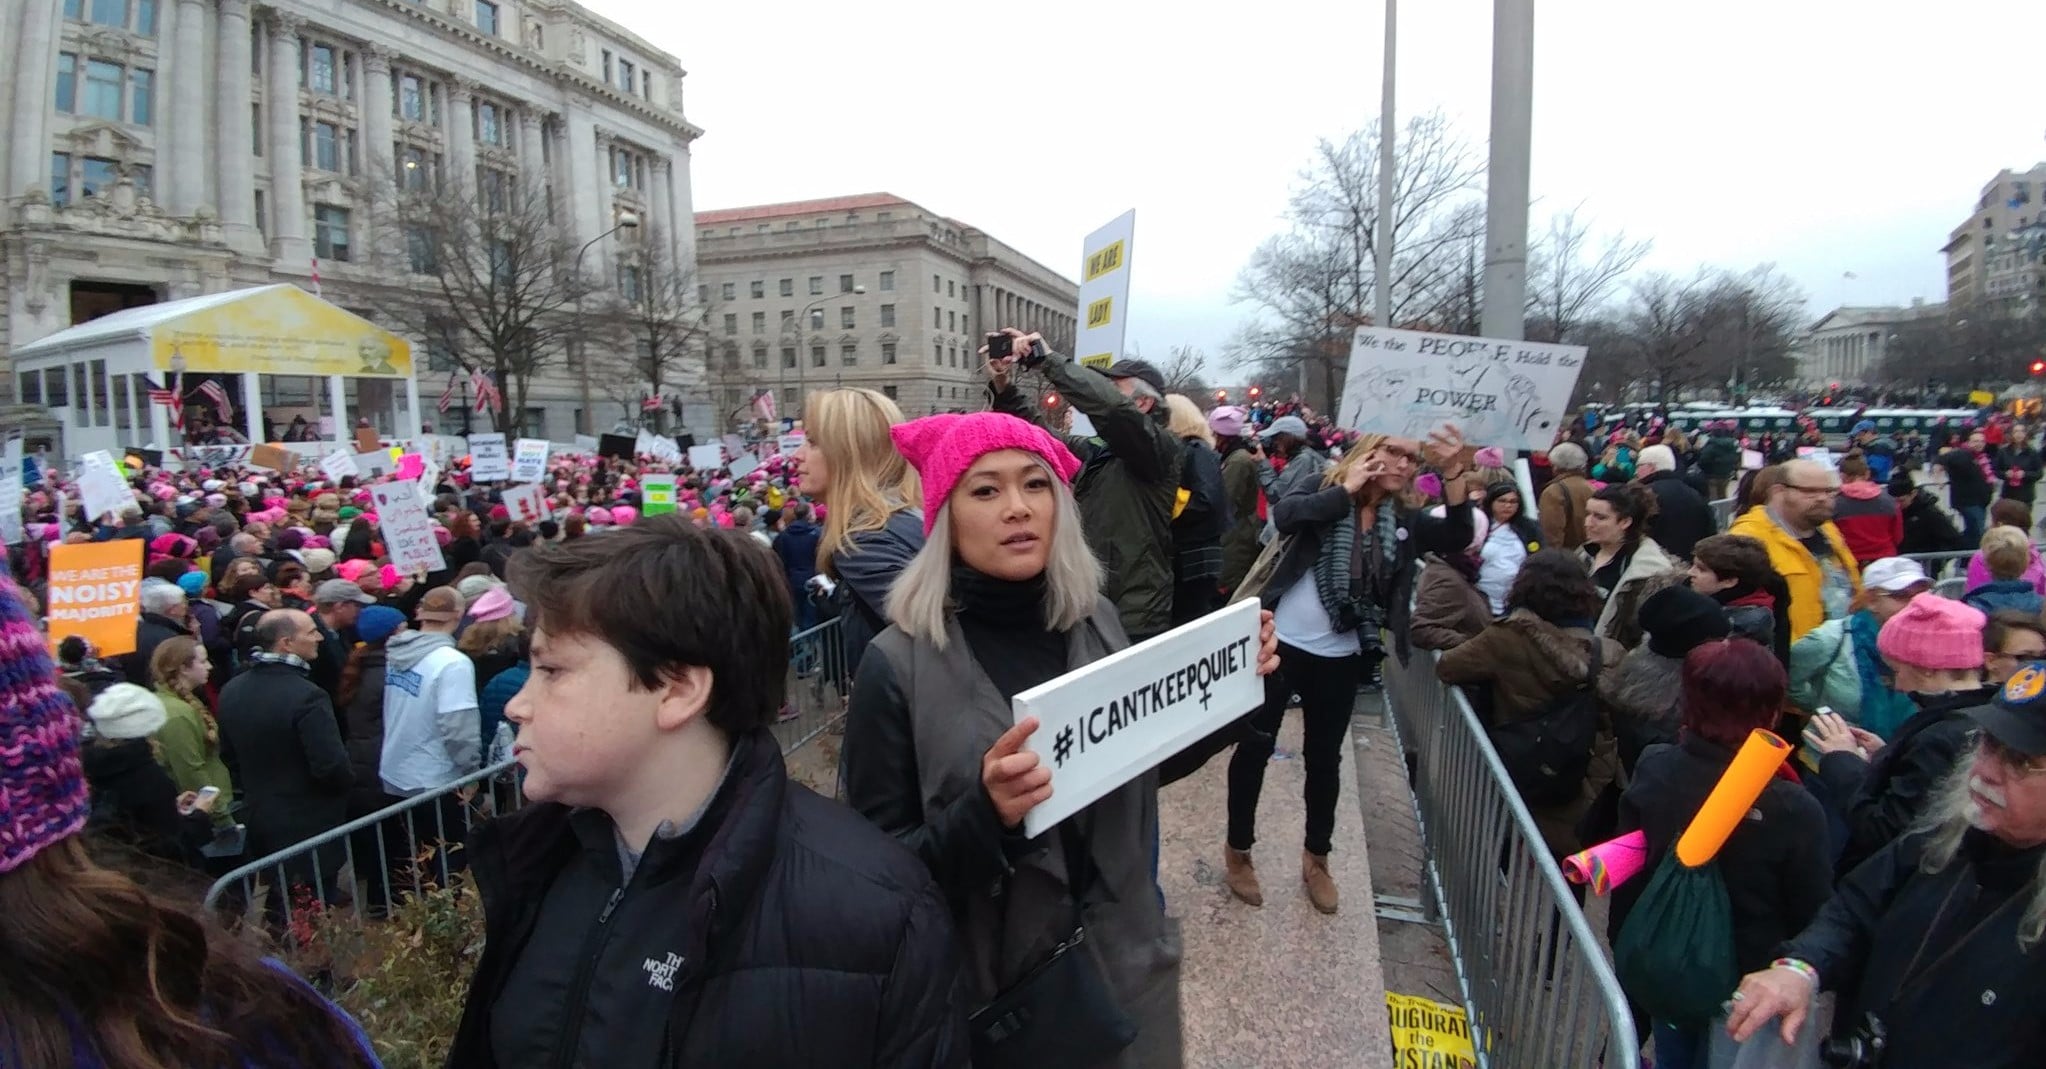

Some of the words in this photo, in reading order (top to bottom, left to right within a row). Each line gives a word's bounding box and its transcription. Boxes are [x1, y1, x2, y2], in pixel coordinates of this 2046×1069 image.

[1090, 254, 1101, 277] WE
[1101, 245, 1119, 272] ARE
[1089, 301, 1110, 325] LADY
[1358, 334, 1379, 349] We
[1416, 337, 1512, 362] PEOPE
[1514, 350, 1553, 366] Hold
[1413, 387, 1498, 412] POWER
[51, 569, 78, 582] WE
[79, 567, 109, 581] ARE
[110, 564, 139, 577] THE
[50, 579, 139, 604] NOISY
[50, 602, 137, 623] MAJORITY
[642, 958, 677, 977] NORT
[1410, 1030, 1435, 1048] the
[1392, 1046, 1476, 1069] ISTAN
